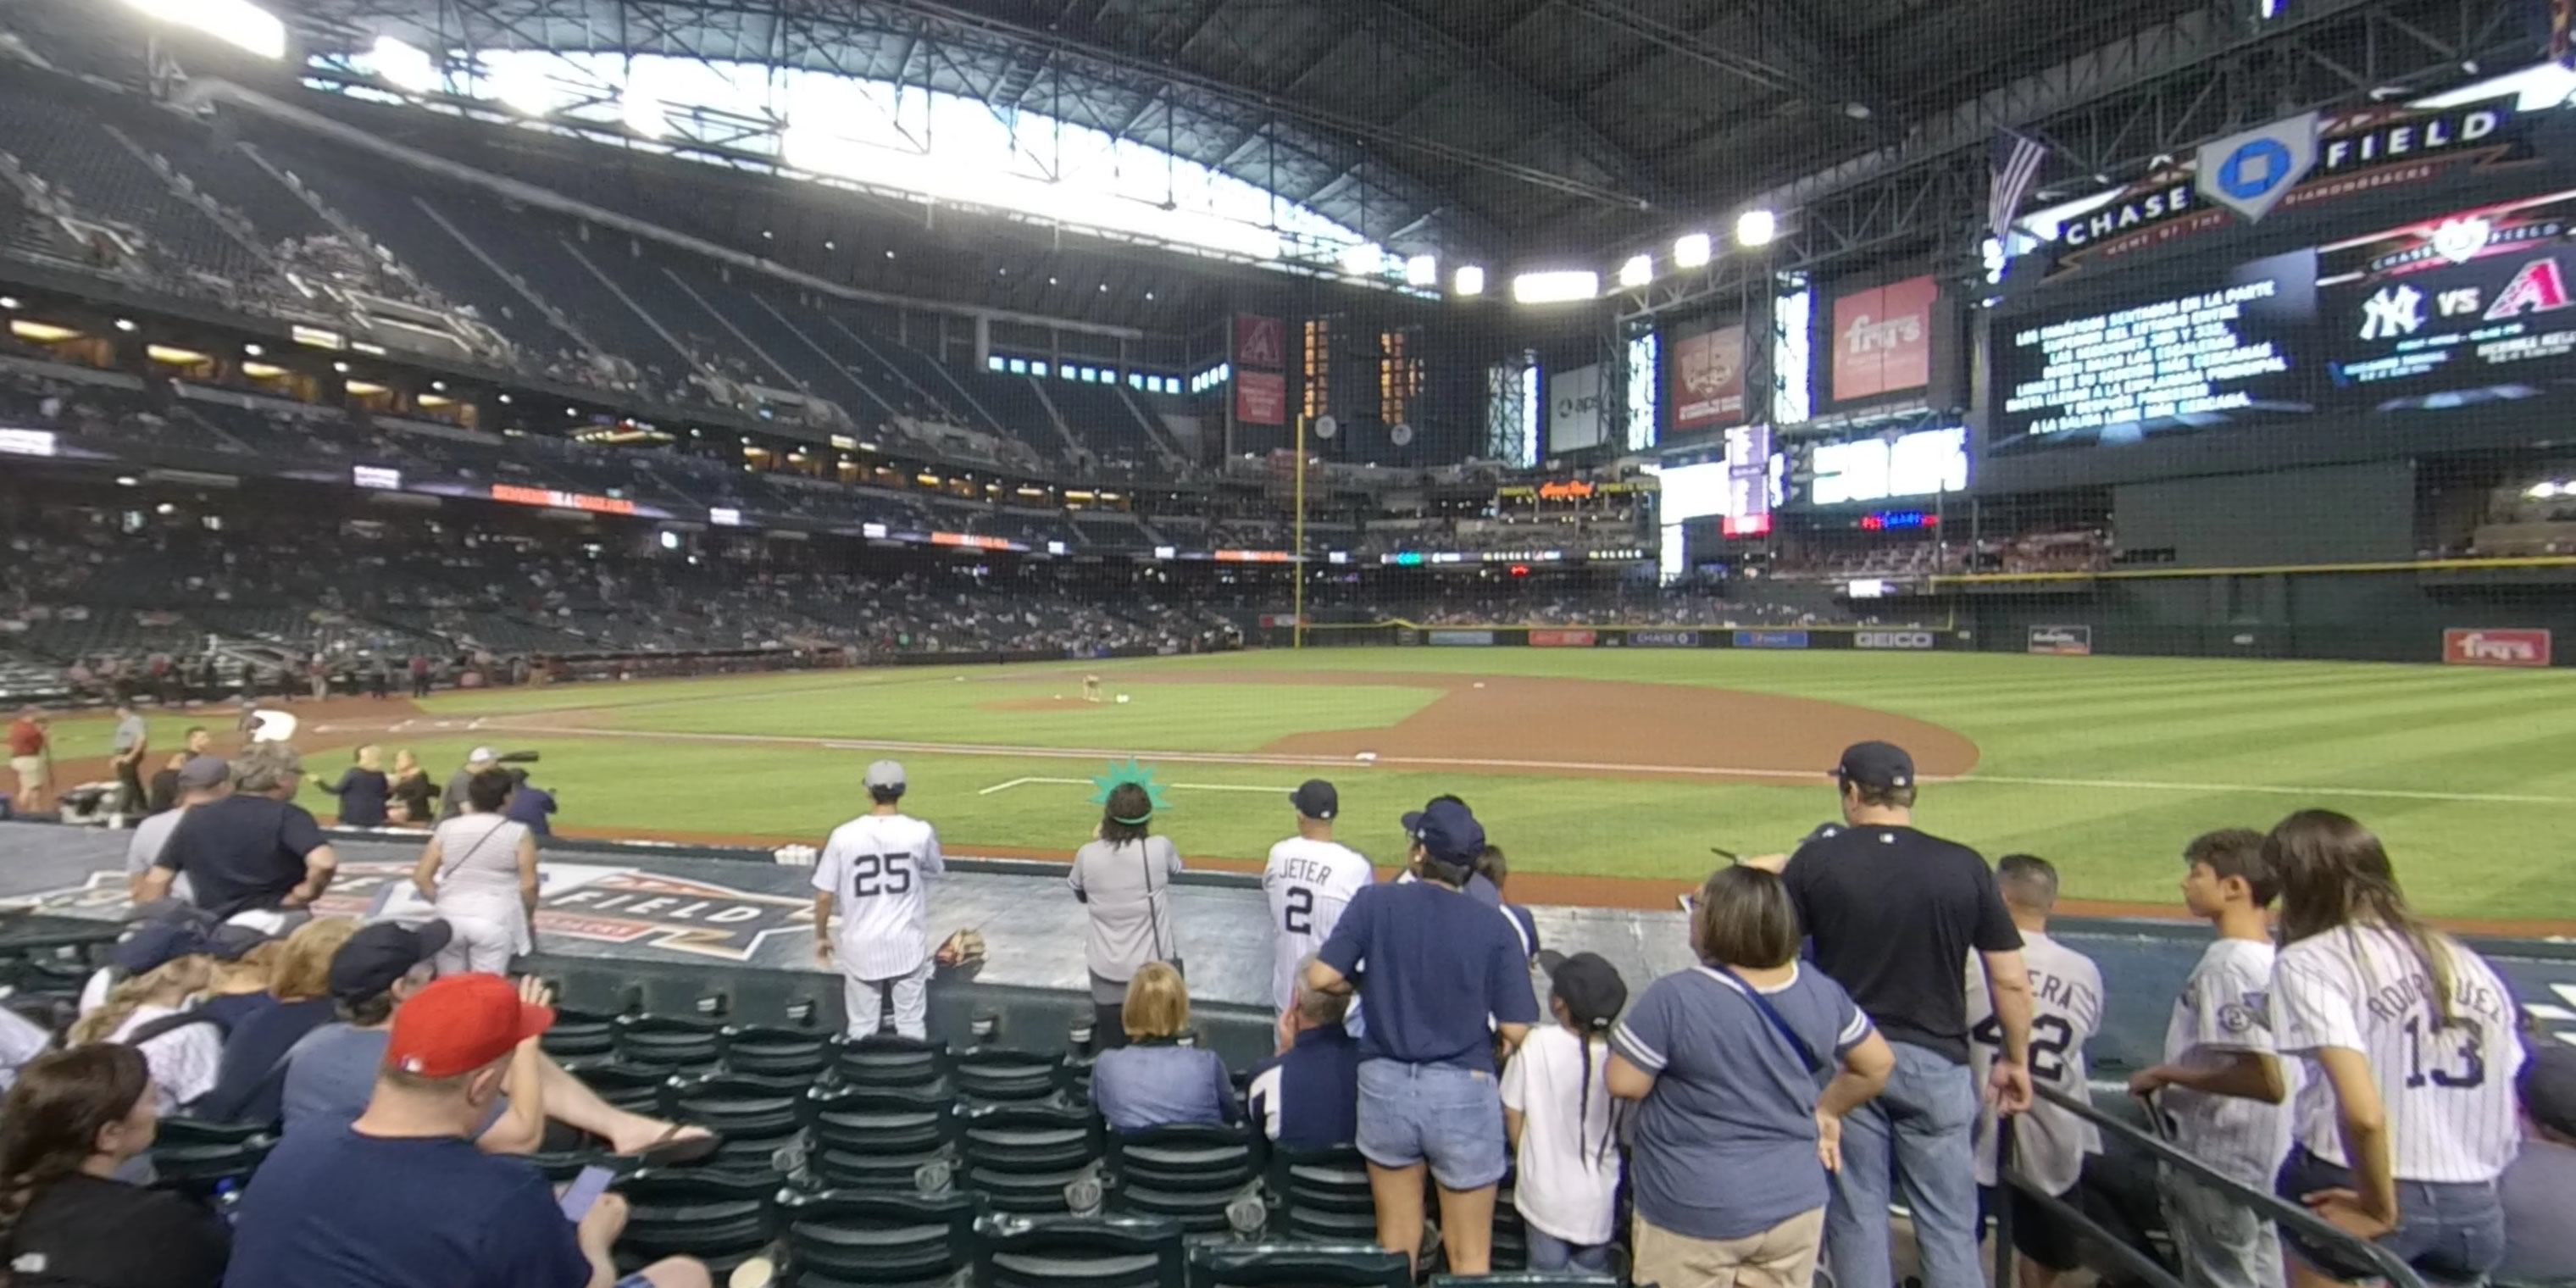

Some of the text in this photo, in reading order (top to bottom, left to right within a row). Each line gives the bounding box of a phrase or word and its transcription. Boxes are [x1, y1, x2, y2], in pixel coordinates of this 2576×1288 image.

[2327, 111, 2496, 169] FIELD
[2066, 186, 2189, 245] CHASE
[2437, 286, 2479, 317] VS
[1637, 633, 1675, 645] CHASE
[1855, 632, 1933, 647] GEICO
[854, 852, 911, 897] 25
[1279, 858, 1333, 887] JETER
[549, 891, 763, 923] FIELD
[1285, 886, 1314, 936] 2
[2404, 1014, 2485, 1089] 13
